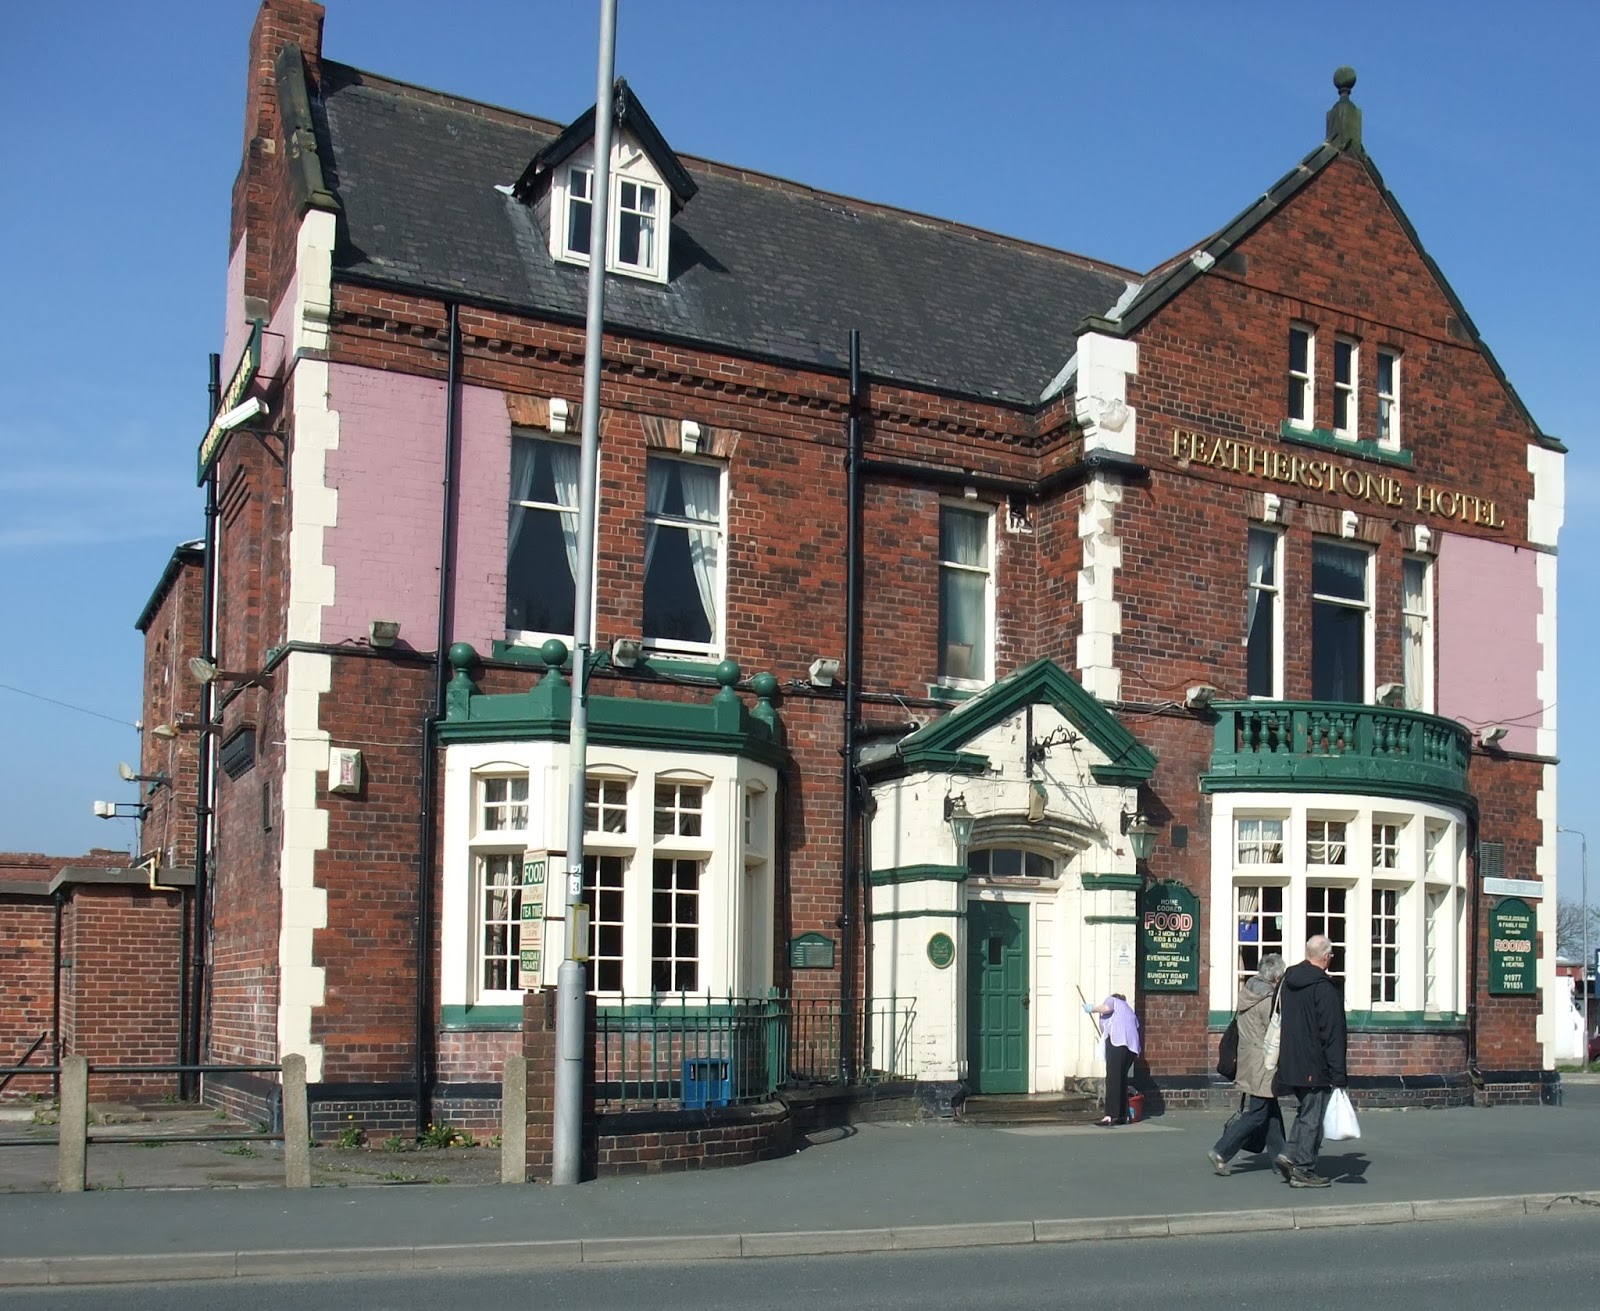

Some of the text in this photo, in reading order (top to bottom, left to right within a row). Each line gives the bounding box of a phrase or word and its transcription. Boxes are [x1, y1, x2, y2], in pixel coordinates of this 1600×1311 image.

[1172, 427, 1505, 529] FEATHERSTONE HOTEL
[524, 863, 545, 884] FOOD
[522, 905, 531, 918] TEA
[1144, 911, 1193, 931] FOOD
[1494, 938, 1531, 953] ROOMS
[521, 951, 540, 961] SUNDAY
[1146, 954, 1171, 962] EVENING
[522, 960, 538, 970] ROAST
[1503, 973, 1522, 981] 01977
